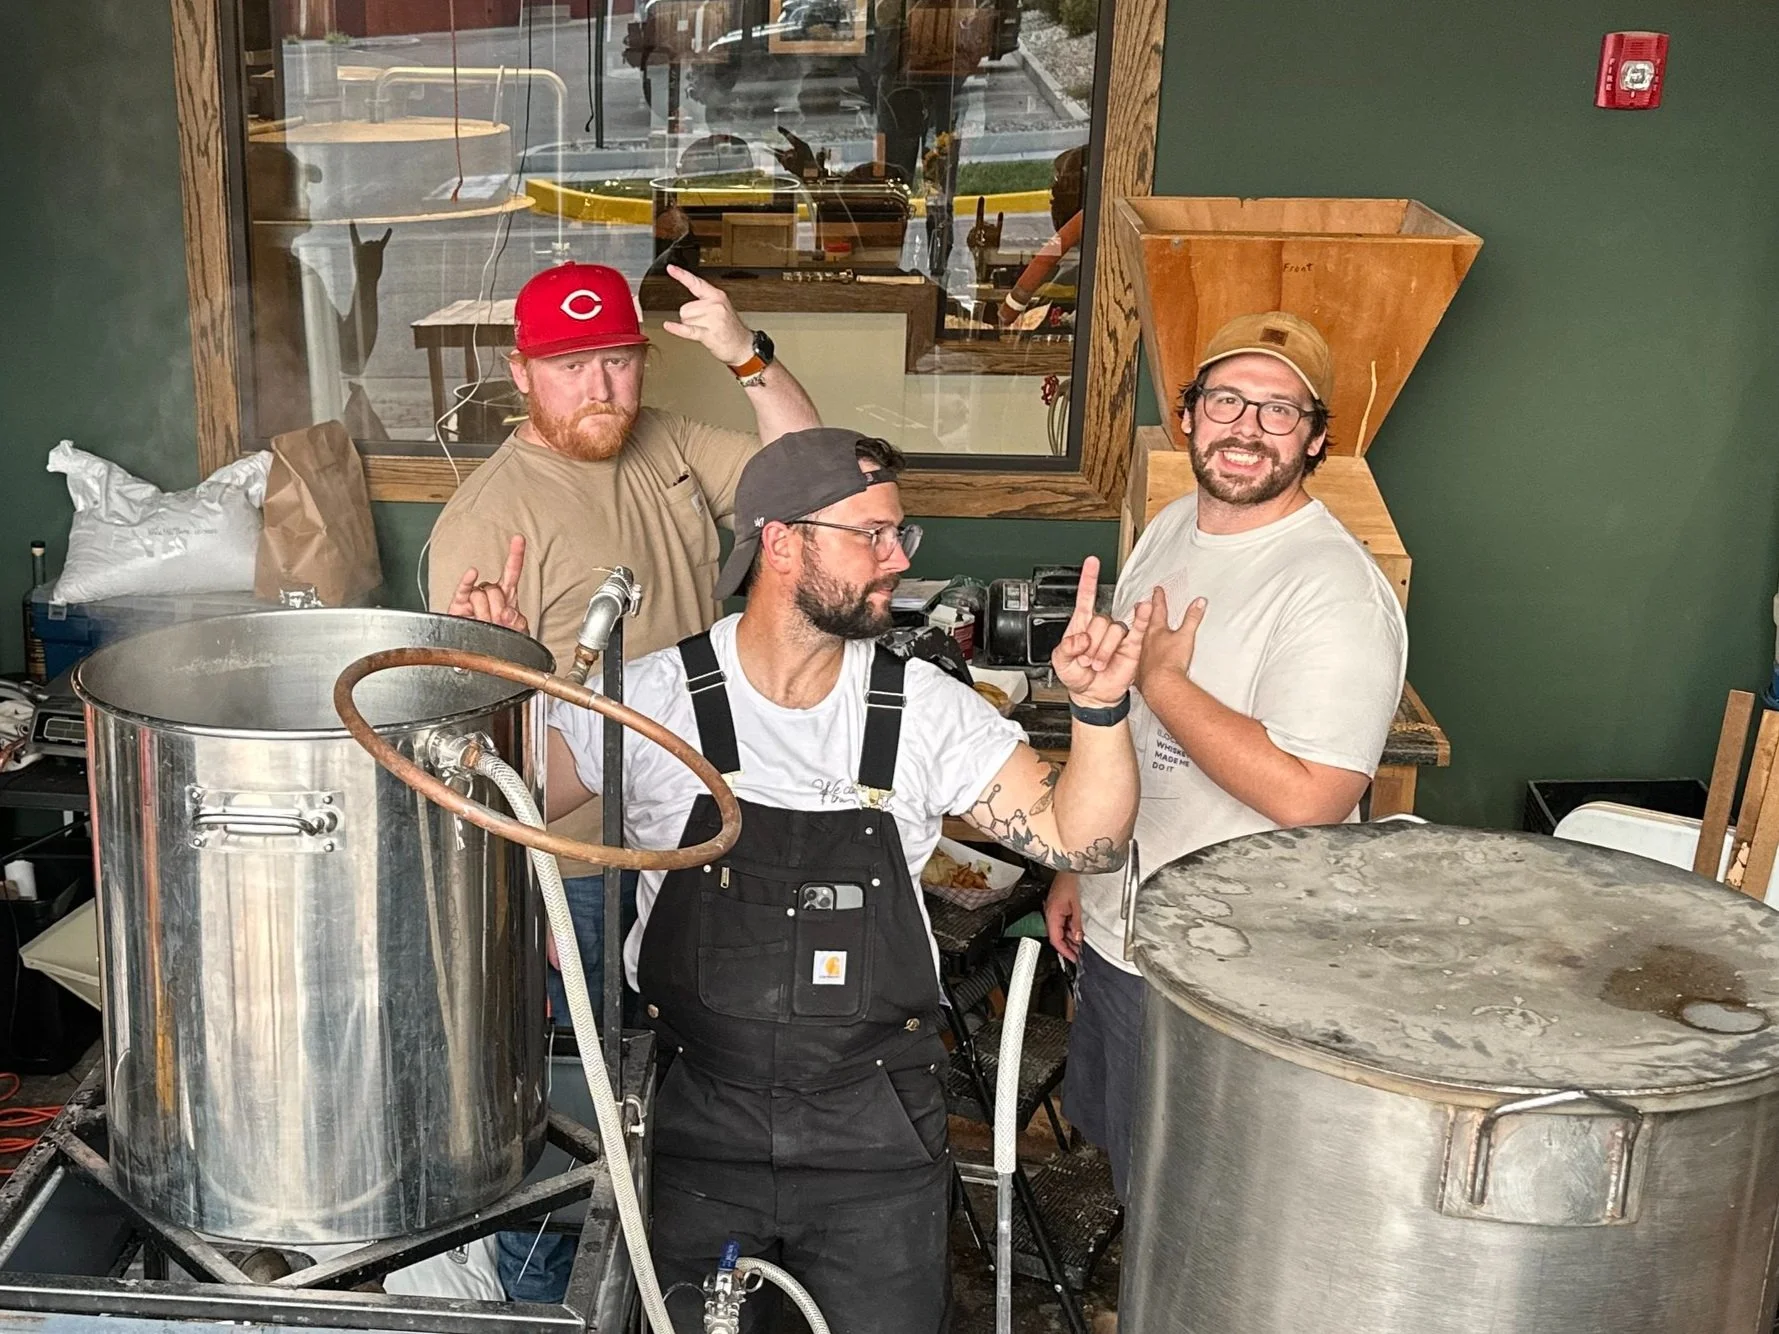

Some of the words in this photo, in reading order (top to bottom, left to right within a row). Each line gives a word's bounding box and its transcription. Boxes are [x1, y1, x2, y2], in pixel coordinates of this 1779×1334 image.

[1605, 58, 1615, 91] FIRE
[1283, 262, 1313, 272] Front
[560, 289, 602, 320] C
[1152, 761, 1165, 770] DO
[1155, 751, 1178, 764] MADE
[1179, 759, 1190, 768] ME
